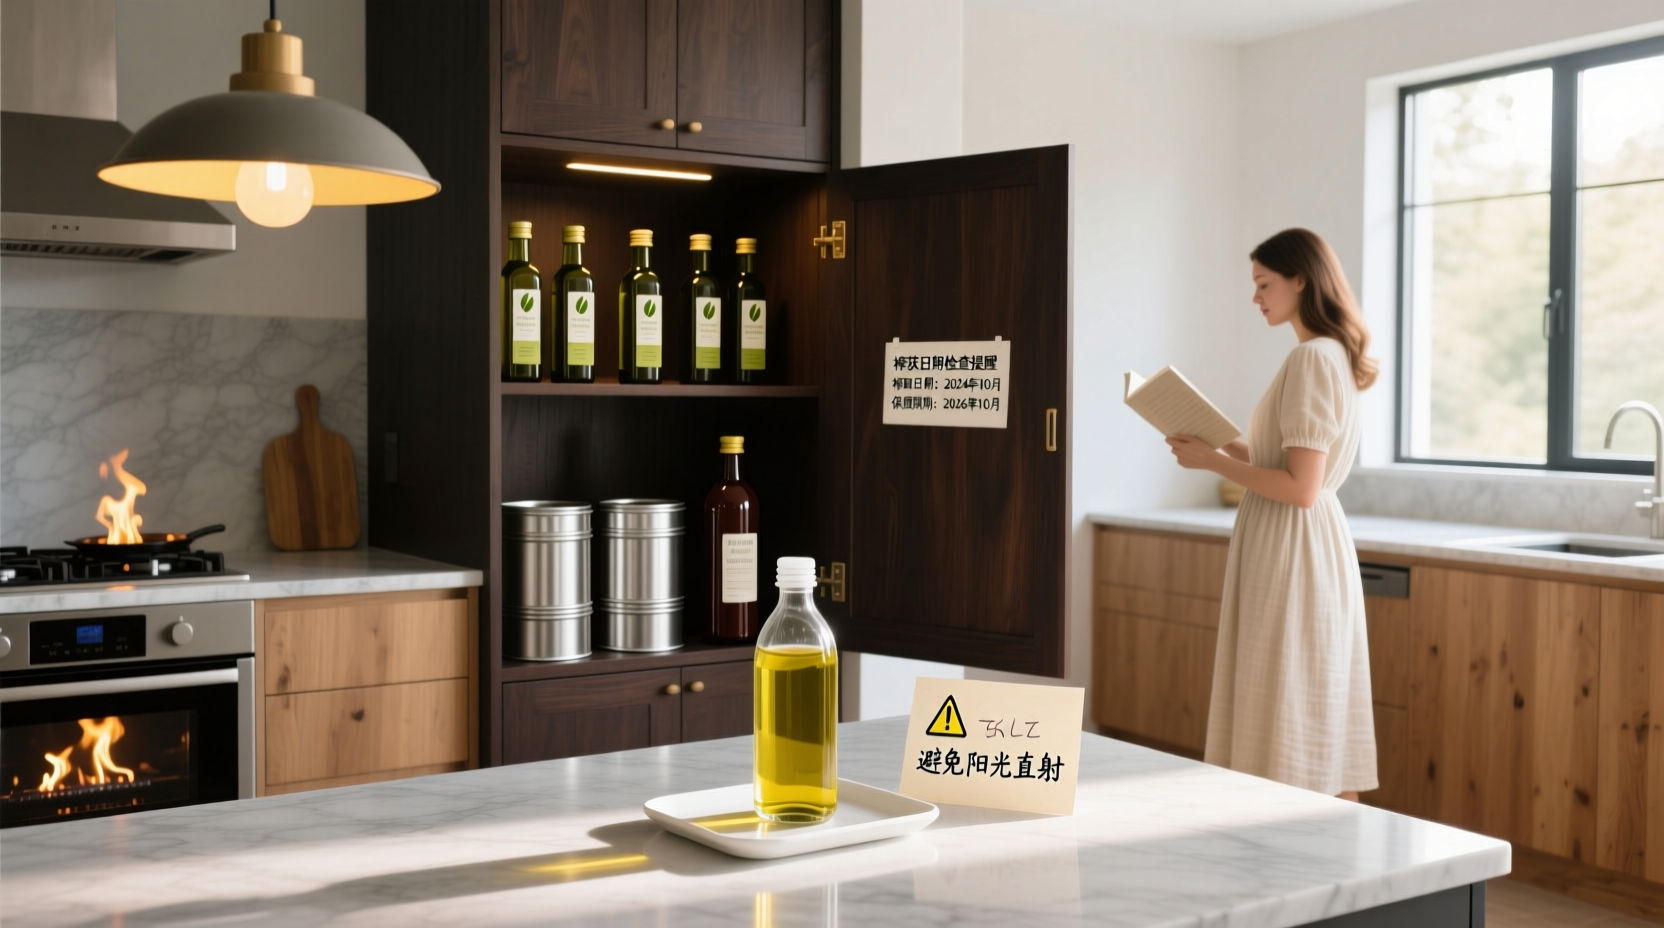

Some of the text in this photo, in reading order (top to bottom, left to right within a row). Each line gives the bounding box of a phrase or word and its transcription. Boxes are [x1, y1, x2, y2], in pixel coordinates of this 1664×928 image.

[916, 747, 1065, 782] 避免阳光直射
